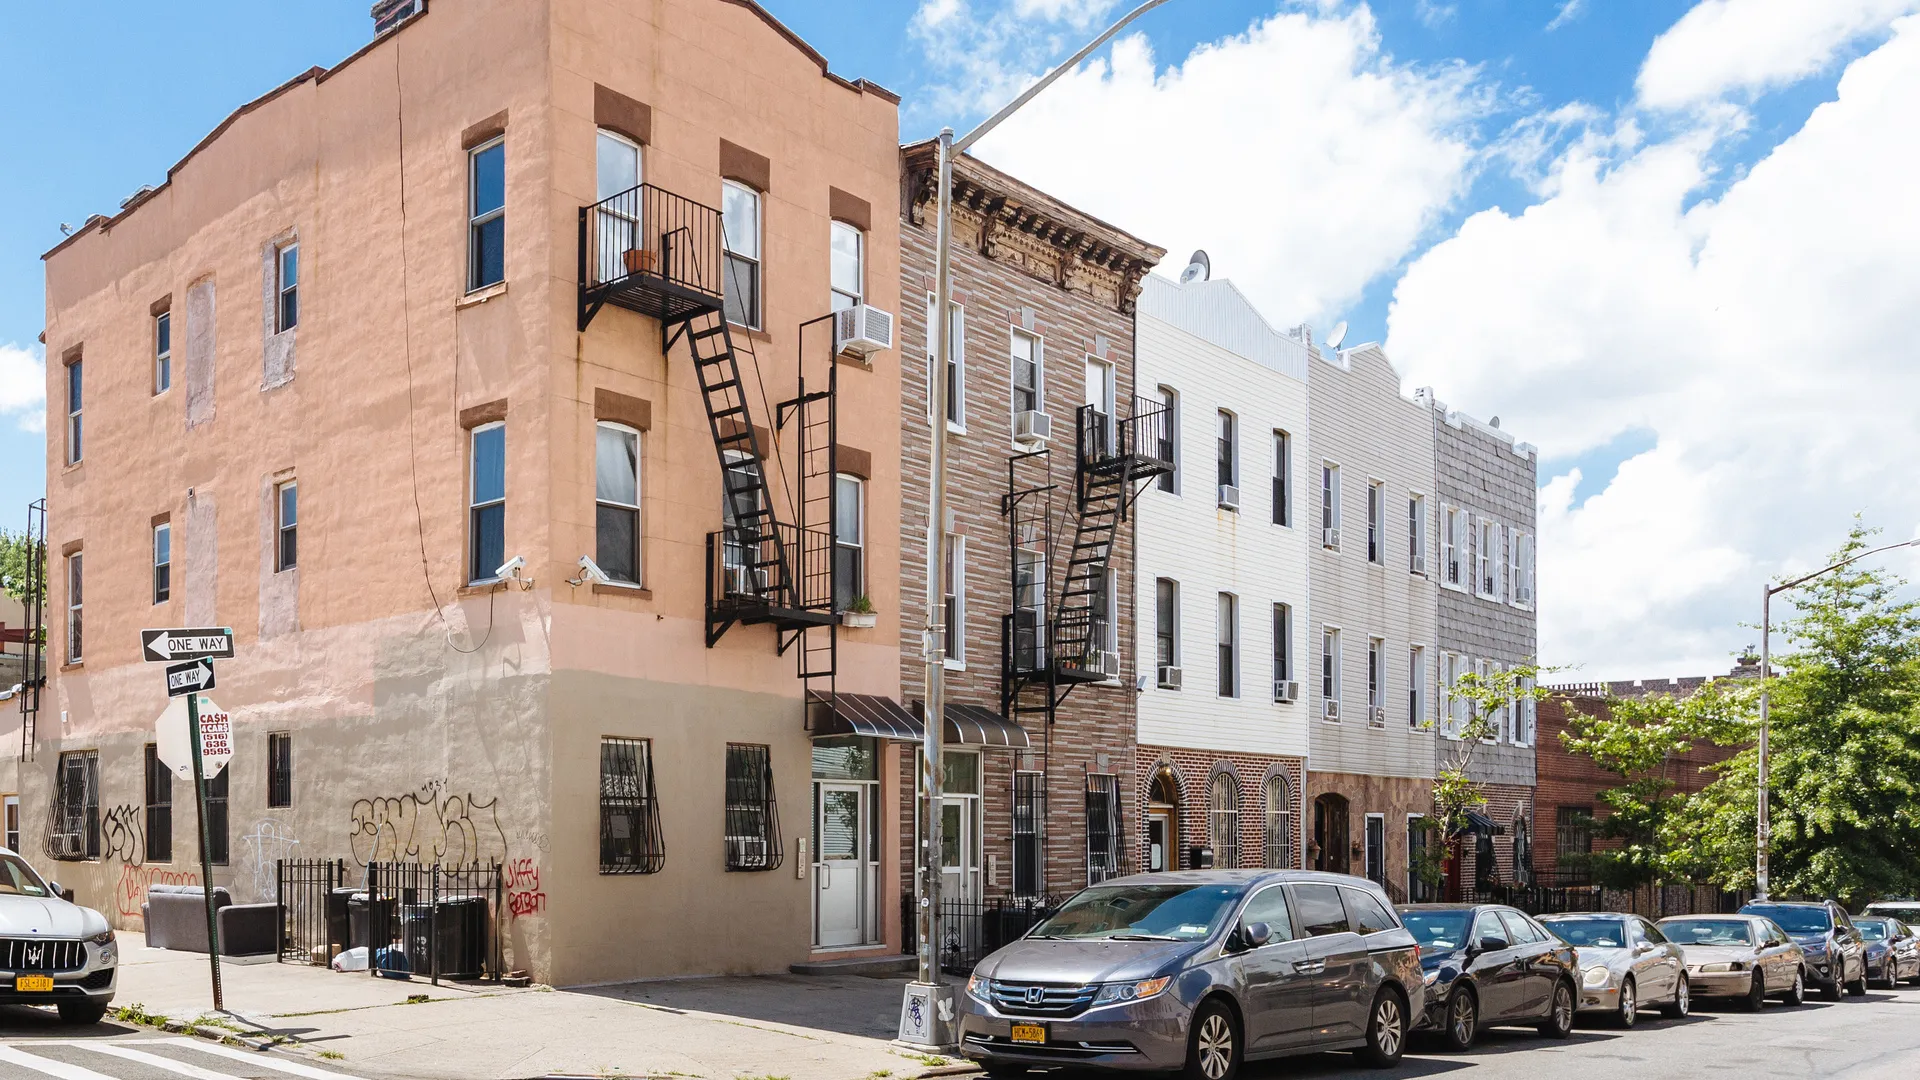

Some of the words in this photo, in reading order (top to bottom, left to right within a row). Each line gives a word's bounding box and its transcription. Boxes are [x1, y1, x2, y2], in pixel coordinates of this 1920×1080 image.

[168, 638, 193, 651] ONE
[199, 637, 224, 650] WAY
[170, 673, 183, 688] ONE
[185, 670, 200, 683] WAY
[203, 733, 228, 741] (516)
[205, 740, 227, 748] 636
[203, 747, 231, 756] 9595
